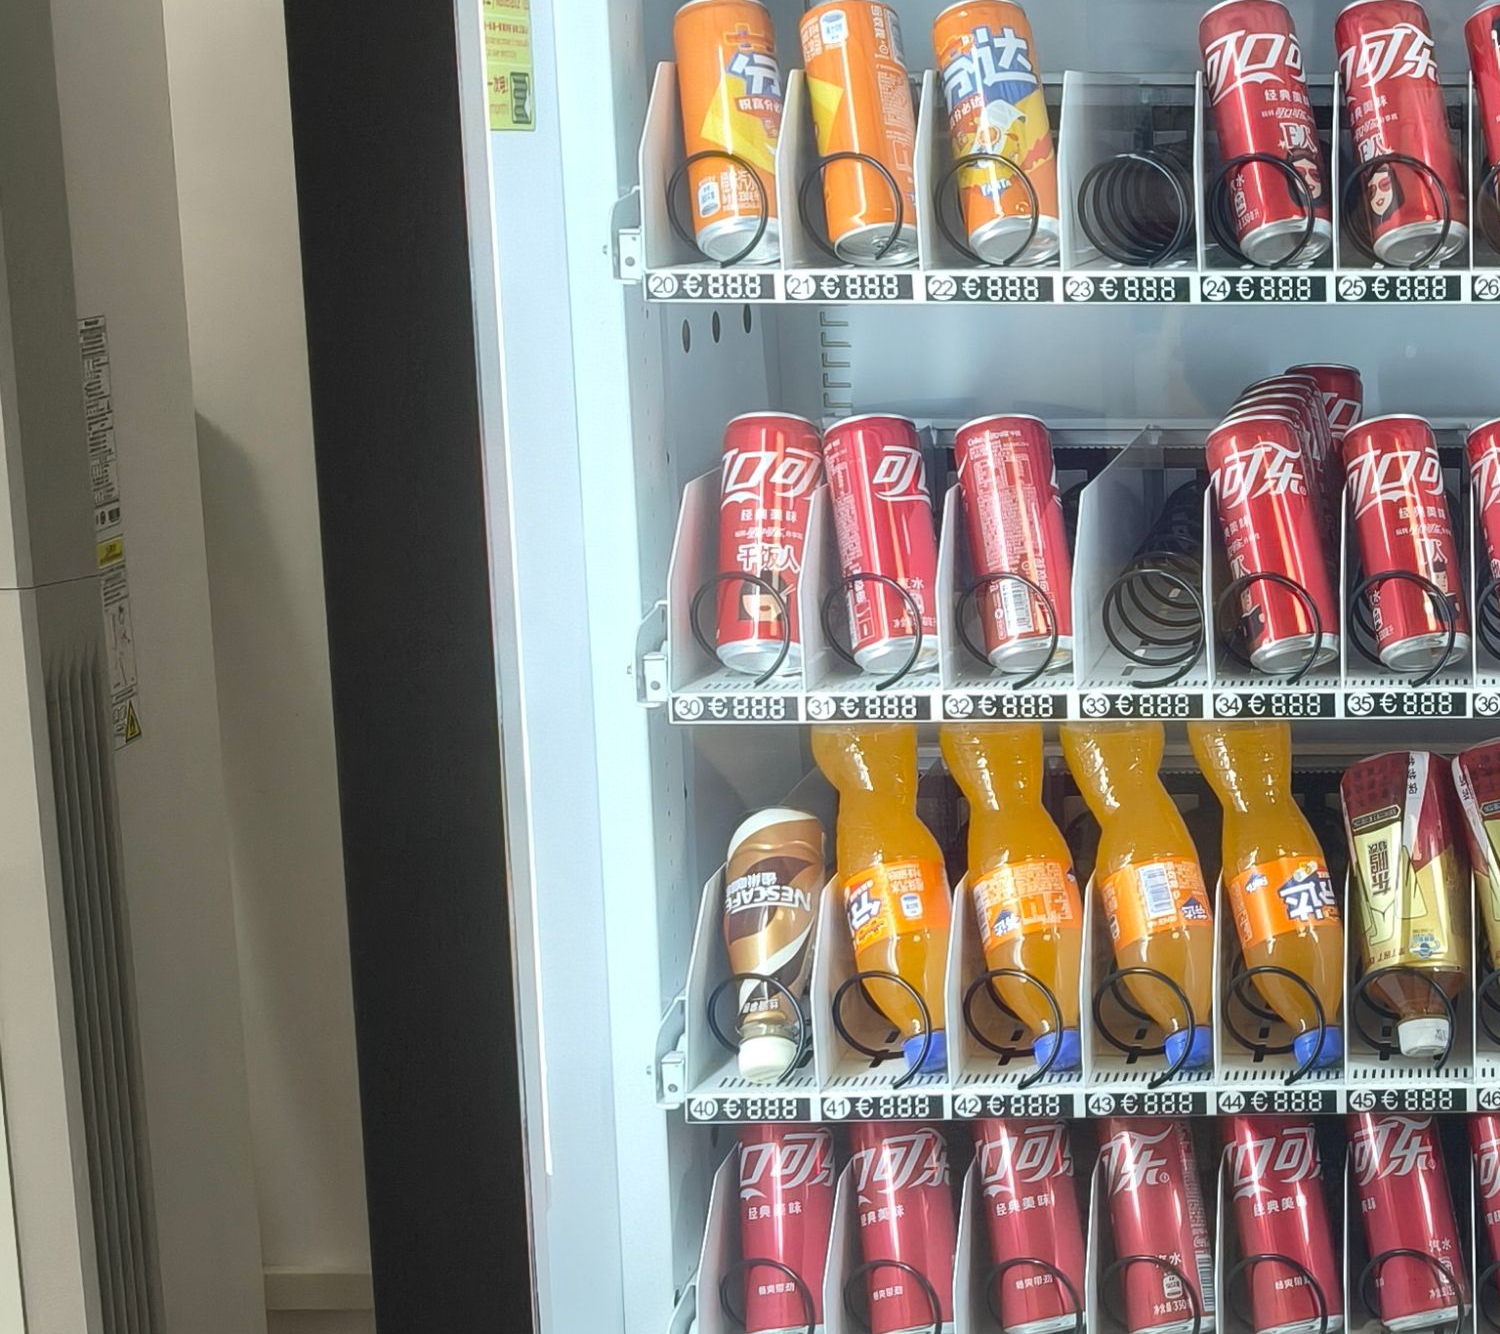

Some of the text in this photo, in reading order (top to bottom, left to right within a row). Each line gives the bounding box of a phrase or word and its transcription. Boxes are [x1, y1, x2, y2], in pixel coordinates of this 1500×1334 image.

[1207, 281, 1226, 296] 24
[678, 700, 699, 715] 30
[693, 1100, 714, 1115] 40
